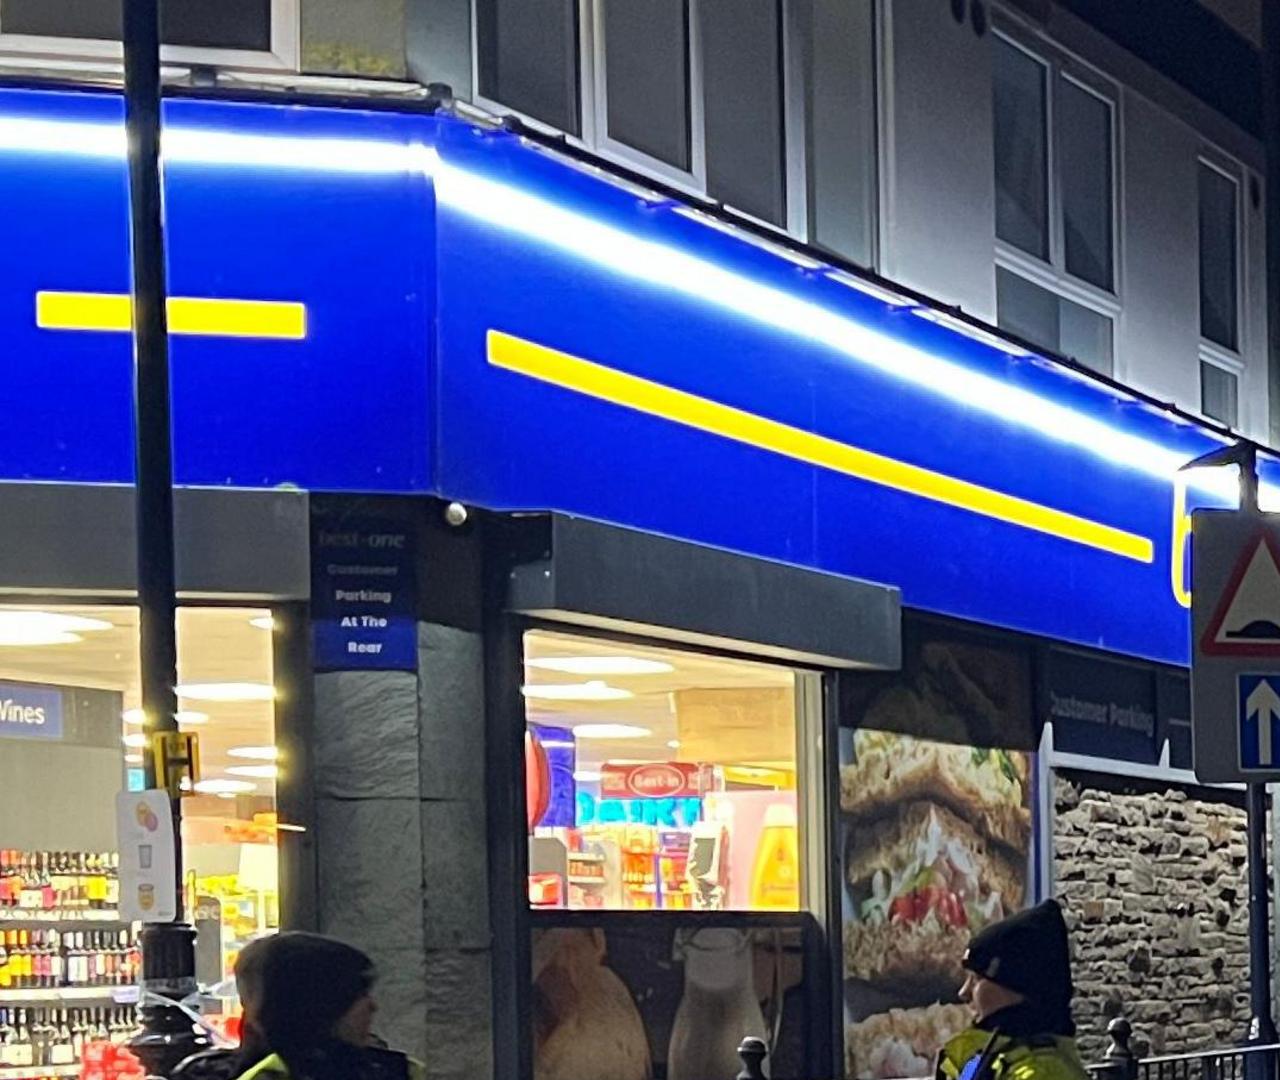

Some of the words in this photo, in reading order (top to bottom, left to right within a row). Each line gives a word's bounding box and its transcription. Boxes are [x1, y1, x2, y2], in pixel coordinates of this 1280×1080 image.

[335, 590, 392, 604] Parking
[340, 615, 358, 628] At
[361, 615, 387, 628] The
[347, 641, 382, 654] Rear
